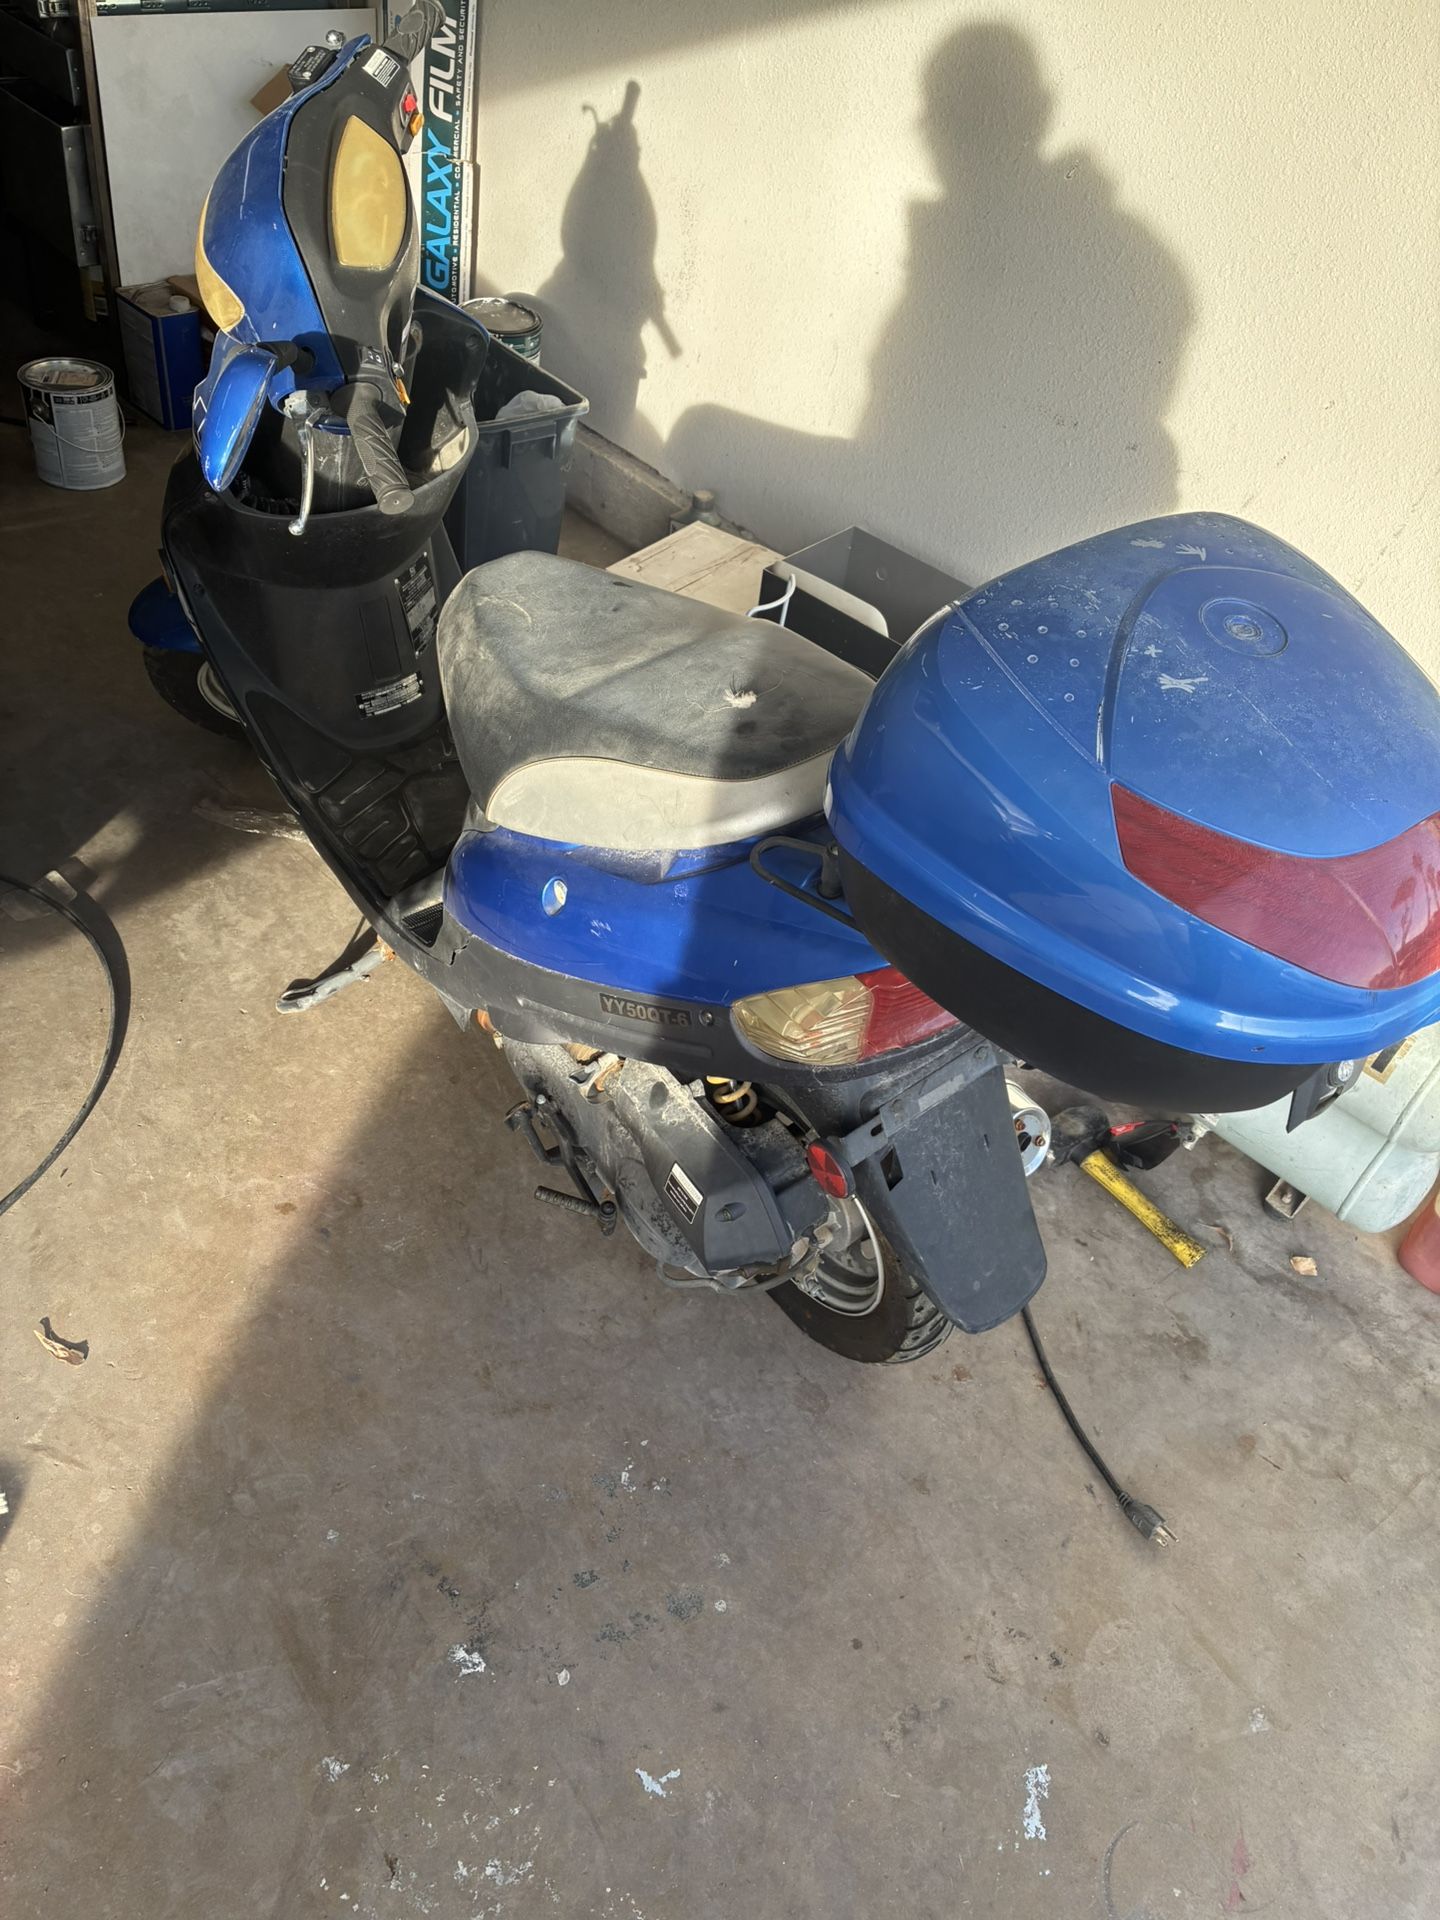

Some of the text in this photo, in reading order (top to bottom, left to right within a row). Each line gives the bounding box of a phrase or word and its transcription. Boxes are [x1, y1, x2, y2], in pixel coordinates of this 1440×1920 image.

[458, 0, 466, 41] SECURIT
[455, 68, 463, 106] SAFETY
[426, 16, 458, 290] GALAXY FILM
[452, 191, 460, 246] RESIDENTIAL
[450, 256, 459, 304] UTOMOTIVE
[602, 996, 689, 1028] YY50QT-6
